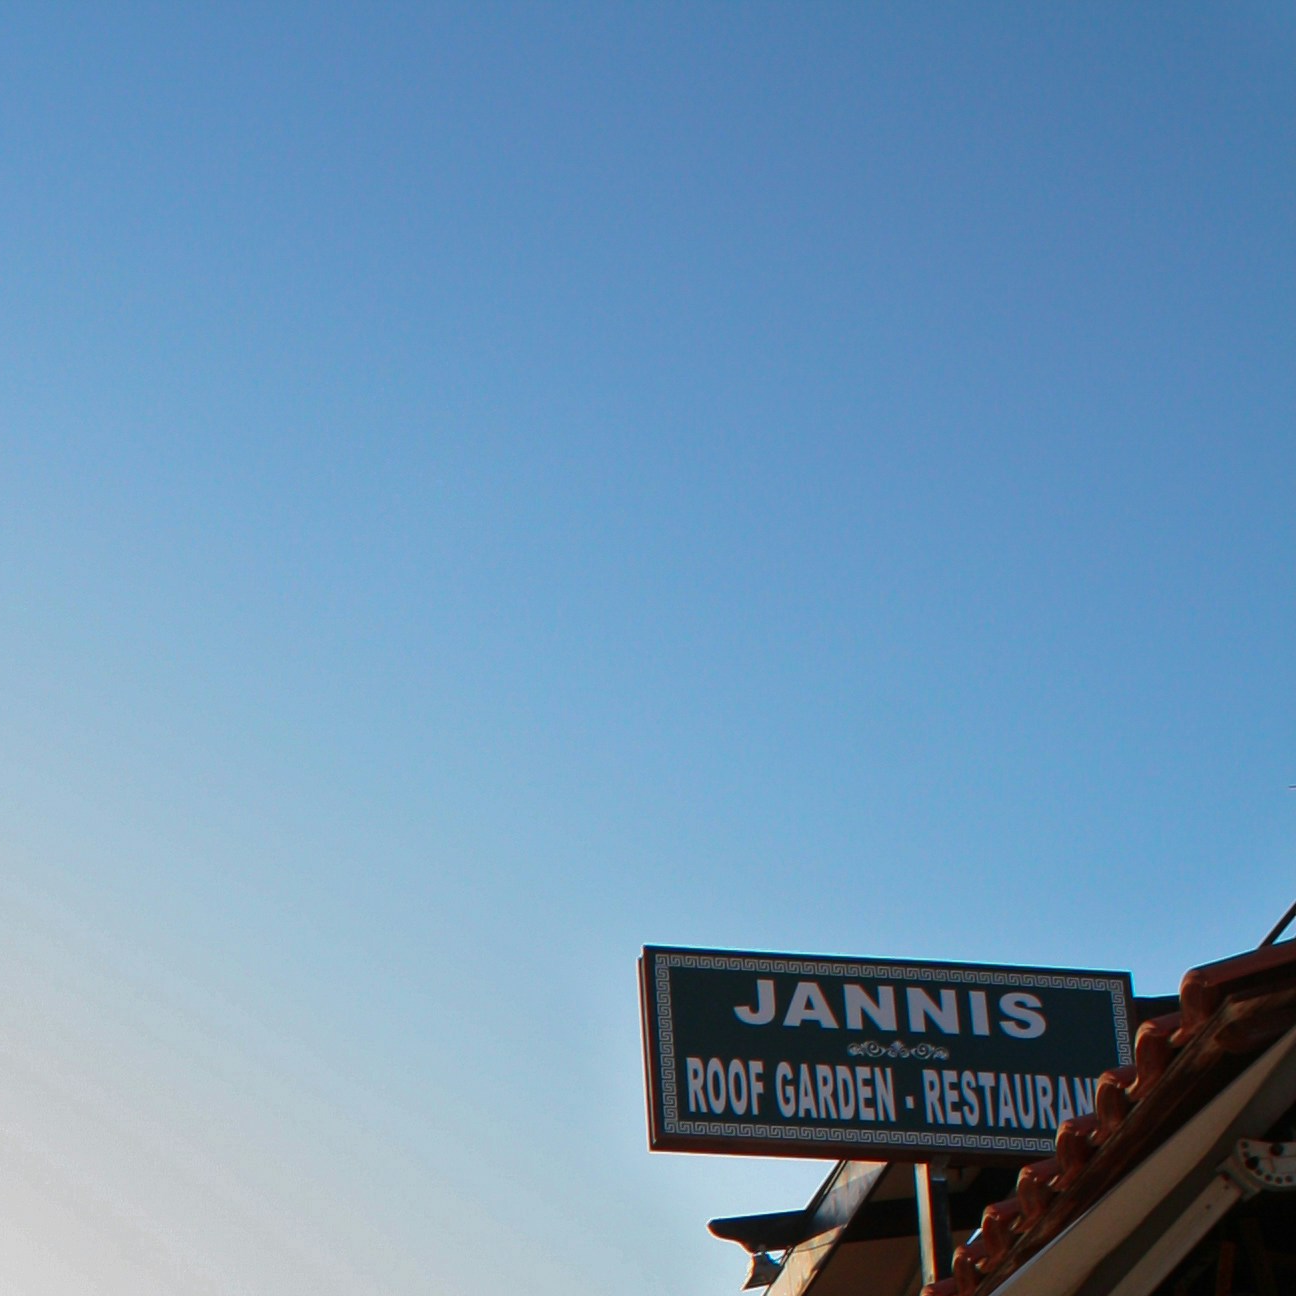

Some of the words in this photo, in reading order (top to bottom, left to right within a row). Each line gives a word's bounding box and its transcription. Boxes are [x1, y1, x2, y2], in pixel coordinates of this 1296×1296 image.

[732, 977, 1048, 1040] JANNIS
[685, 1056, 765, 1117] ROOF
[774, 1061, 897, 1123] GARDEN
[921, 1068, 1100, 1131] RESTAURAN
